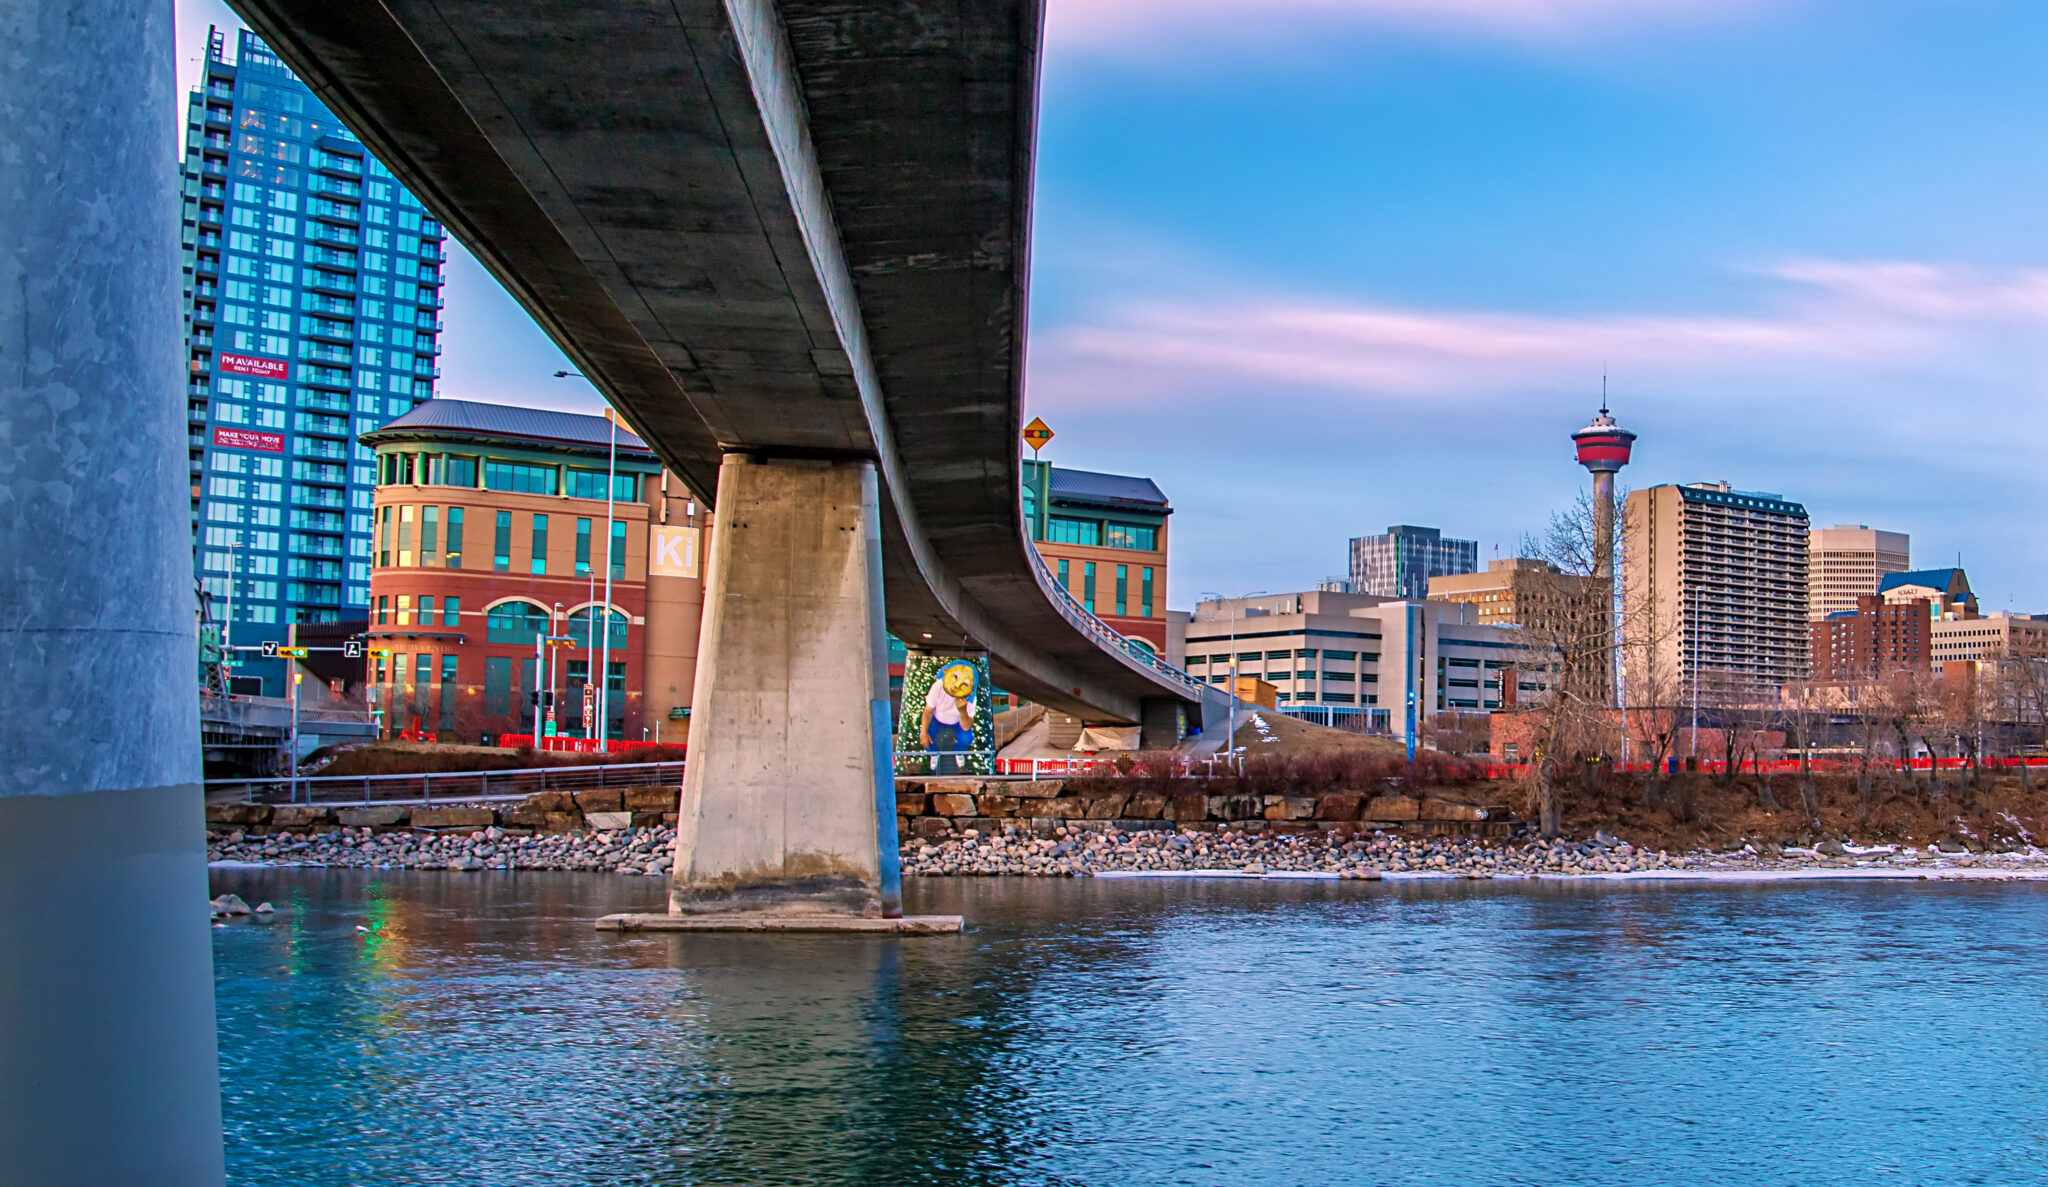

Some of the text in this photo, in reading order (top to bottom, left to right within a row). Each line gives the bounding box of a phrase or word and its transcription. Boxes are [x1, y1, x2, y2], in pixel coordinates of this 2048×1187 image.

[222, 356, 284, 371] I'M AVAILABLE
[218, 430, 280, 443] MAKE YOUR MOVE
[656, 534, 693, 567] Ki
[1897, 588, 1918, 597] HYATT
